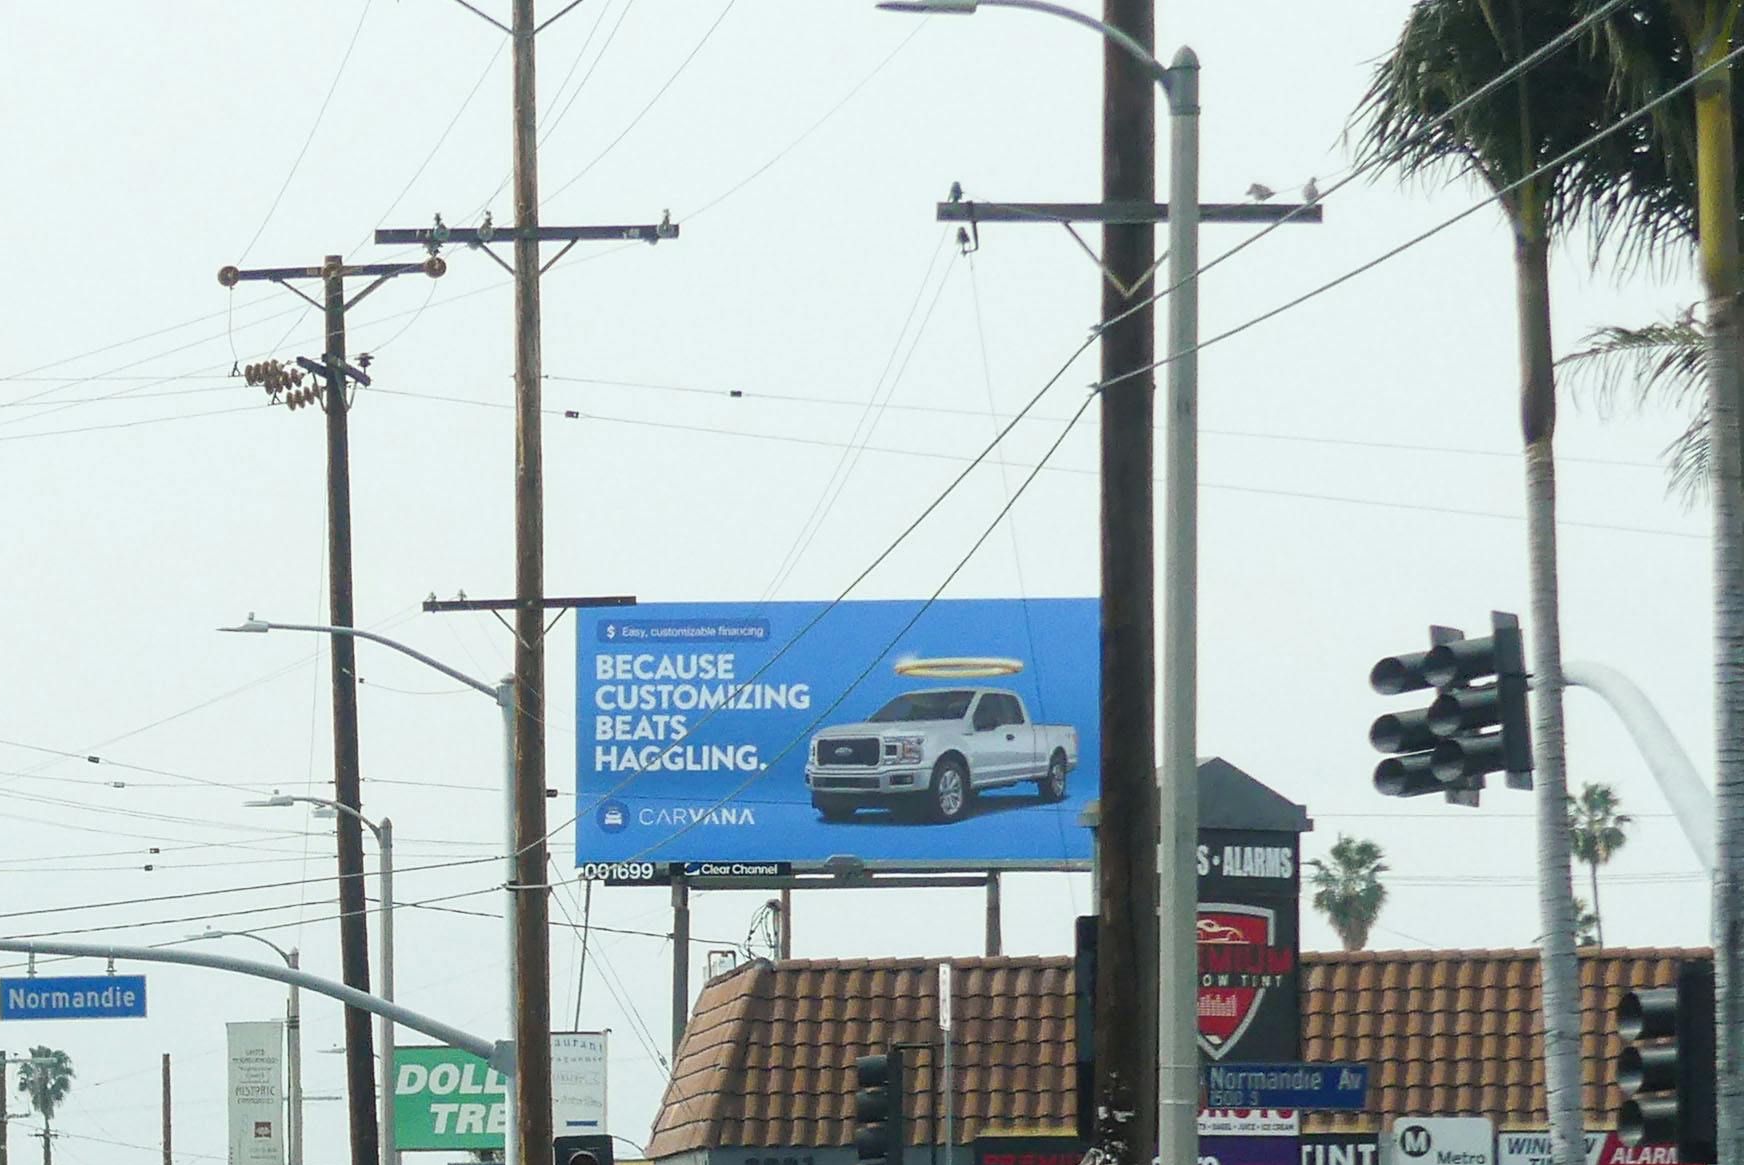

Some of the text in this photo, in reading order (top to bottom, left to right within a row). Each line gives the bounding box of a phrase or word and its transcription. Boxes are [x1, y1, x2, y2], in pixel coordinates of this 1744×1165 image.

[622, 626, 648, 639] Easy,
[651, 625, 716, 638] customizable
[718, 625, 764, 639] financing
[595, 653, 735, 681] BECAUSE
[595, 683, 811, 711] CUSTOMIZING
[595, 714, 688, 741] BEATS
[594, 744, 768, 772] HAGGLING.
[638, 807, 756, 825] CARVANA
[584, 863, 654, 880] 001699
[700, 863, 778, 875] Clear Channel
[1222, 846, 1293, 879] ALARMS
[8, 986, 136, 1010] Normandie
[394, 1062, 506, 1096] DOLL
[1210, 1066, 1361, 1091] Normandie Av
[430, 1103, 506, 1134] TRE
[1436, 1150, 1486, 1165] Metro
